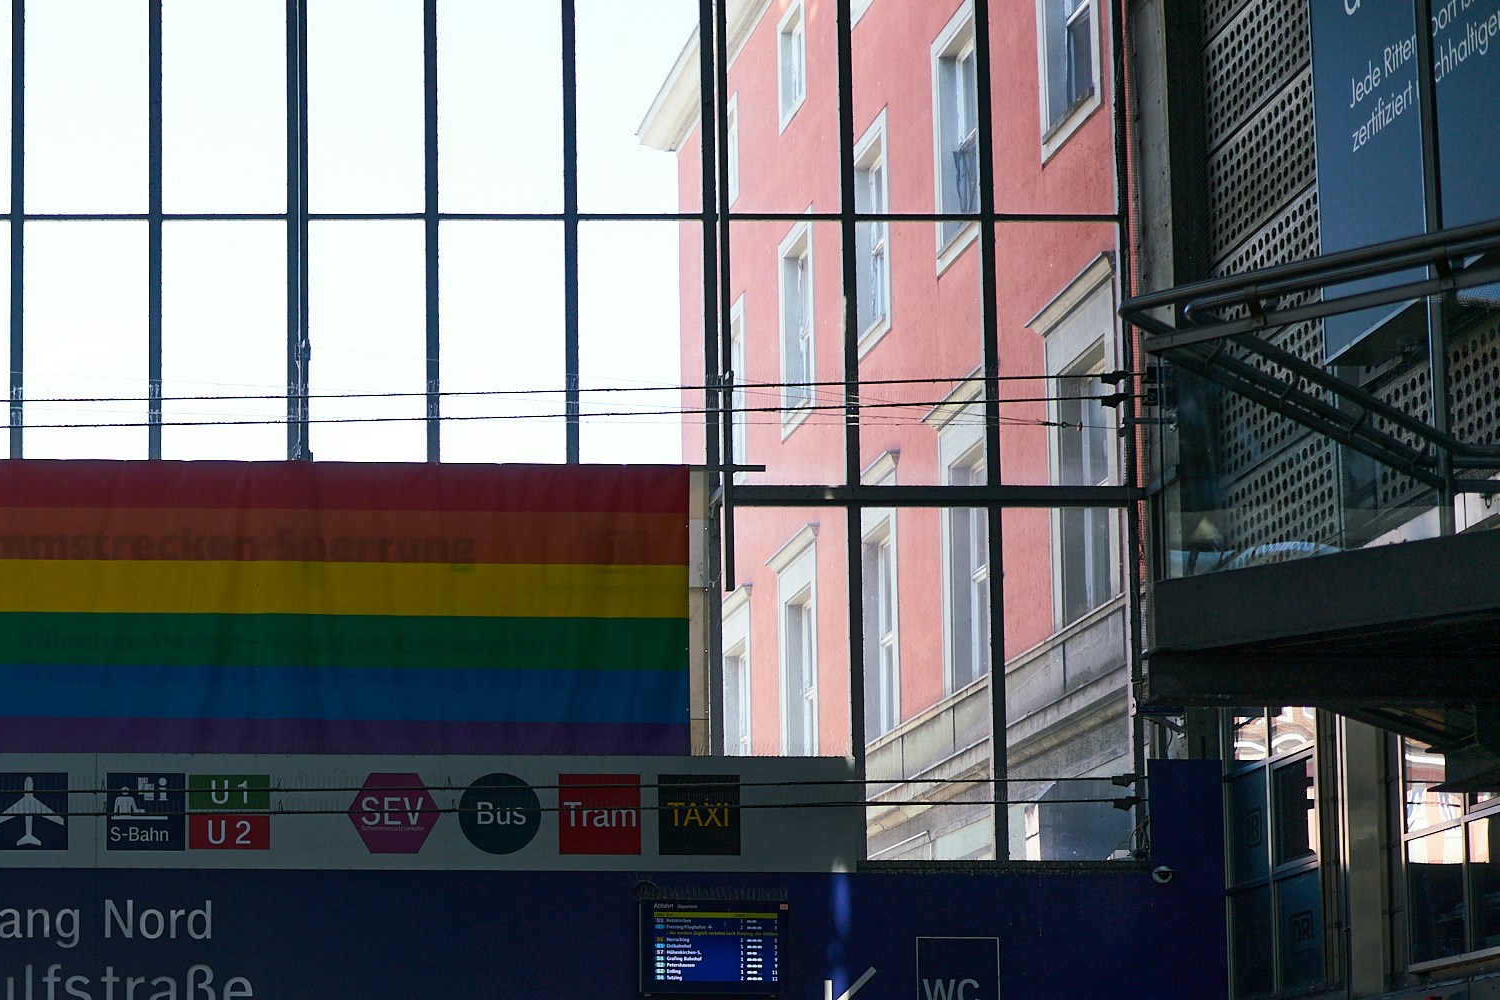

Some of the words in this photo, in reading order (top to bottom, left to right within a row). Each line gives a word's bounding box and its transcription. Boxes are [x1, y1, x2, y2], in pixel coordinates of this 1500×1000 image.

[1350, 60, 1381, 108] Jede
[1431, 0, 1457, 37] port
[1352, 80, 1412, 153] zertifiziert
[361, 796, 424, 826] SEV
[476, 800, 527, 827] Bus
[564, 801, 637, 828] Tram
[667, 802, 730, 828] TAXI
[110, 826, 170, 843] S-Bahn
[104, 899, 213, 941] Nord
